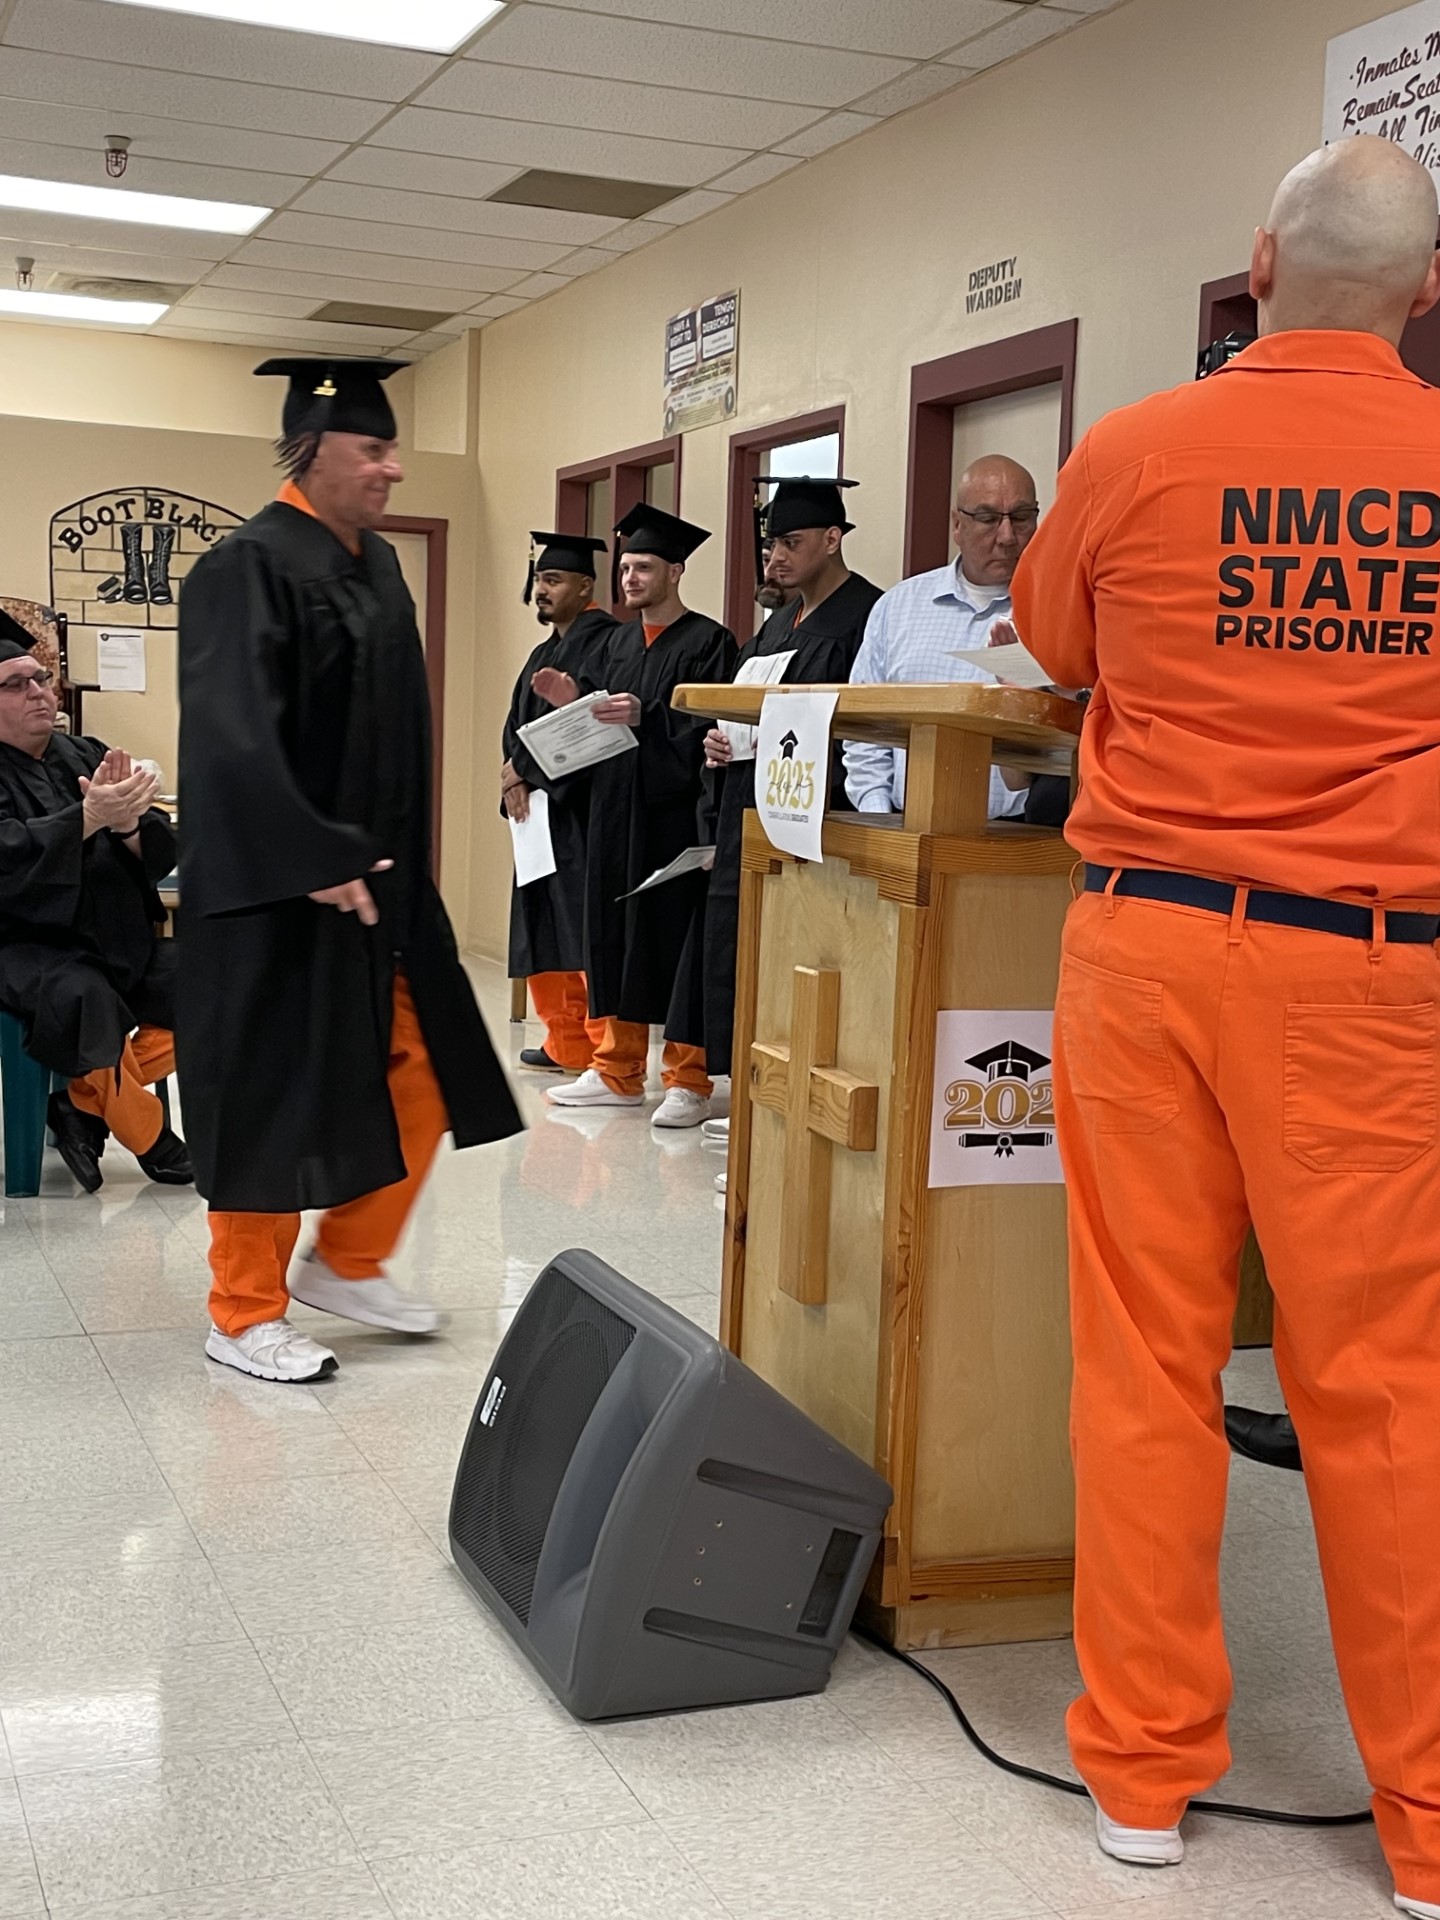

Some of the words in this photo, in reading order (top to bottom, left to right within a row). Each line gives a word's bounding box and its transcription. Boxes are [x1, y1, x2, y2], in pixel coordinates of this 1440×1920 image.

[1356, 47, 1422, 89] Inmates
[1343, 90, 1400, 132] Remain
[968, 256, 1017, 292] DEPUTY
[714, 299, 735, 317] TENGO
[965, 278, 1021, 315] WARDEN
[684, 329, 692, 343] TO
[702, 314, 729, 334] DERECHO
[730, 312, 735, 325] A
[58, 498, 136, 554] BOOT
[1220, 488, 1440, 549] NMCD
[1218, 554, 1440, 614] STATE
[1215, 614, 1434, 656] PRISONER
[765, 758, 816, 810] 2023
